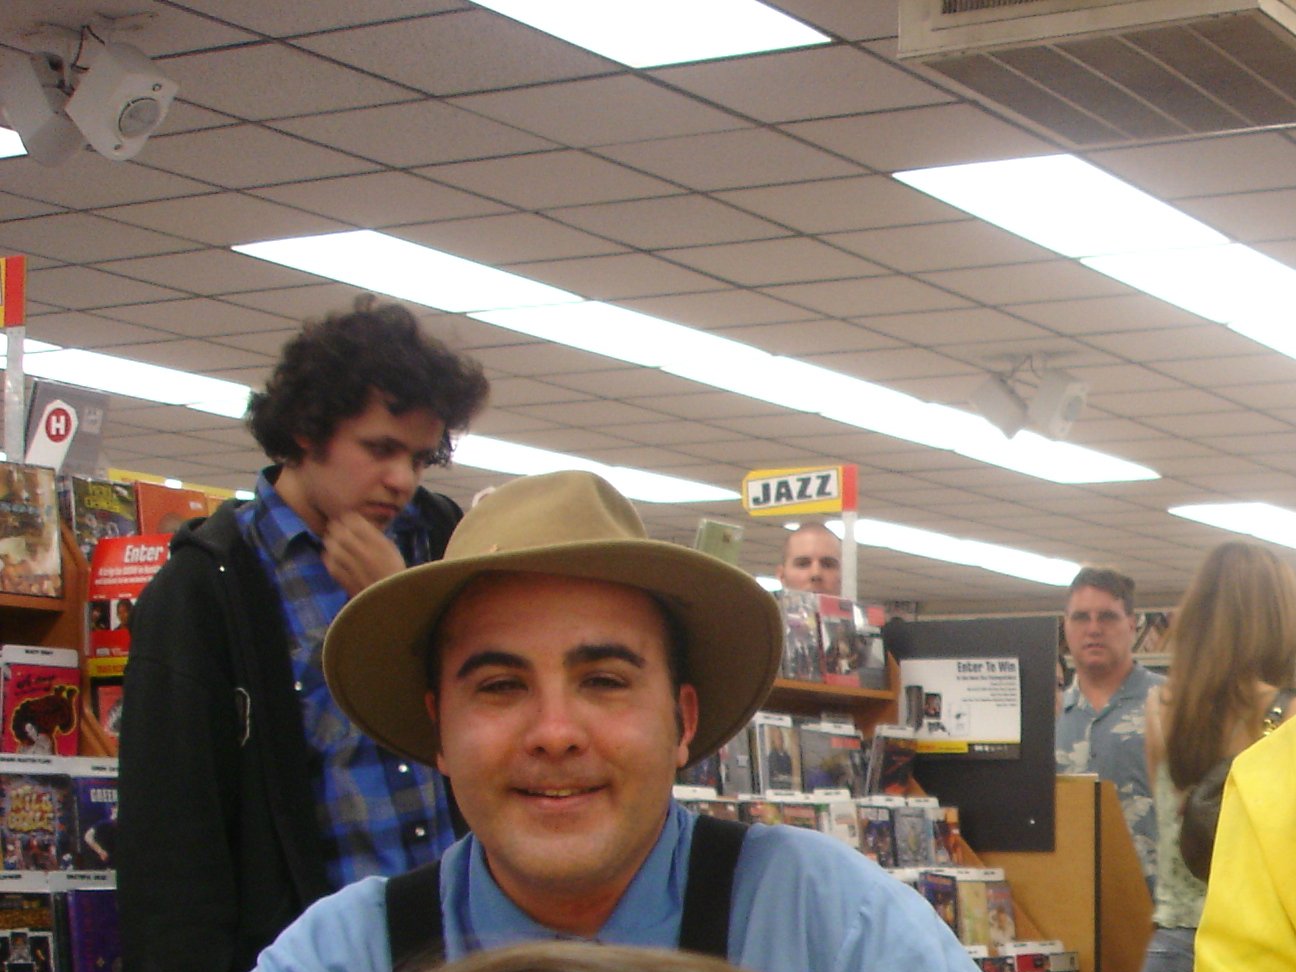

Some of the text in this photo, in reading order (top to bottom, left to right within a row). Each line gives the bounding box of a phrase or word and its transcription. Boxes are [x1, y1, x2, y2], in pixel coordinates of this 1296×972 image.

[752, 473, 833, 506] JAZZ
[124, 544, 164, 563] Enter
[957, 661, 1016, 673] Enter To Win
